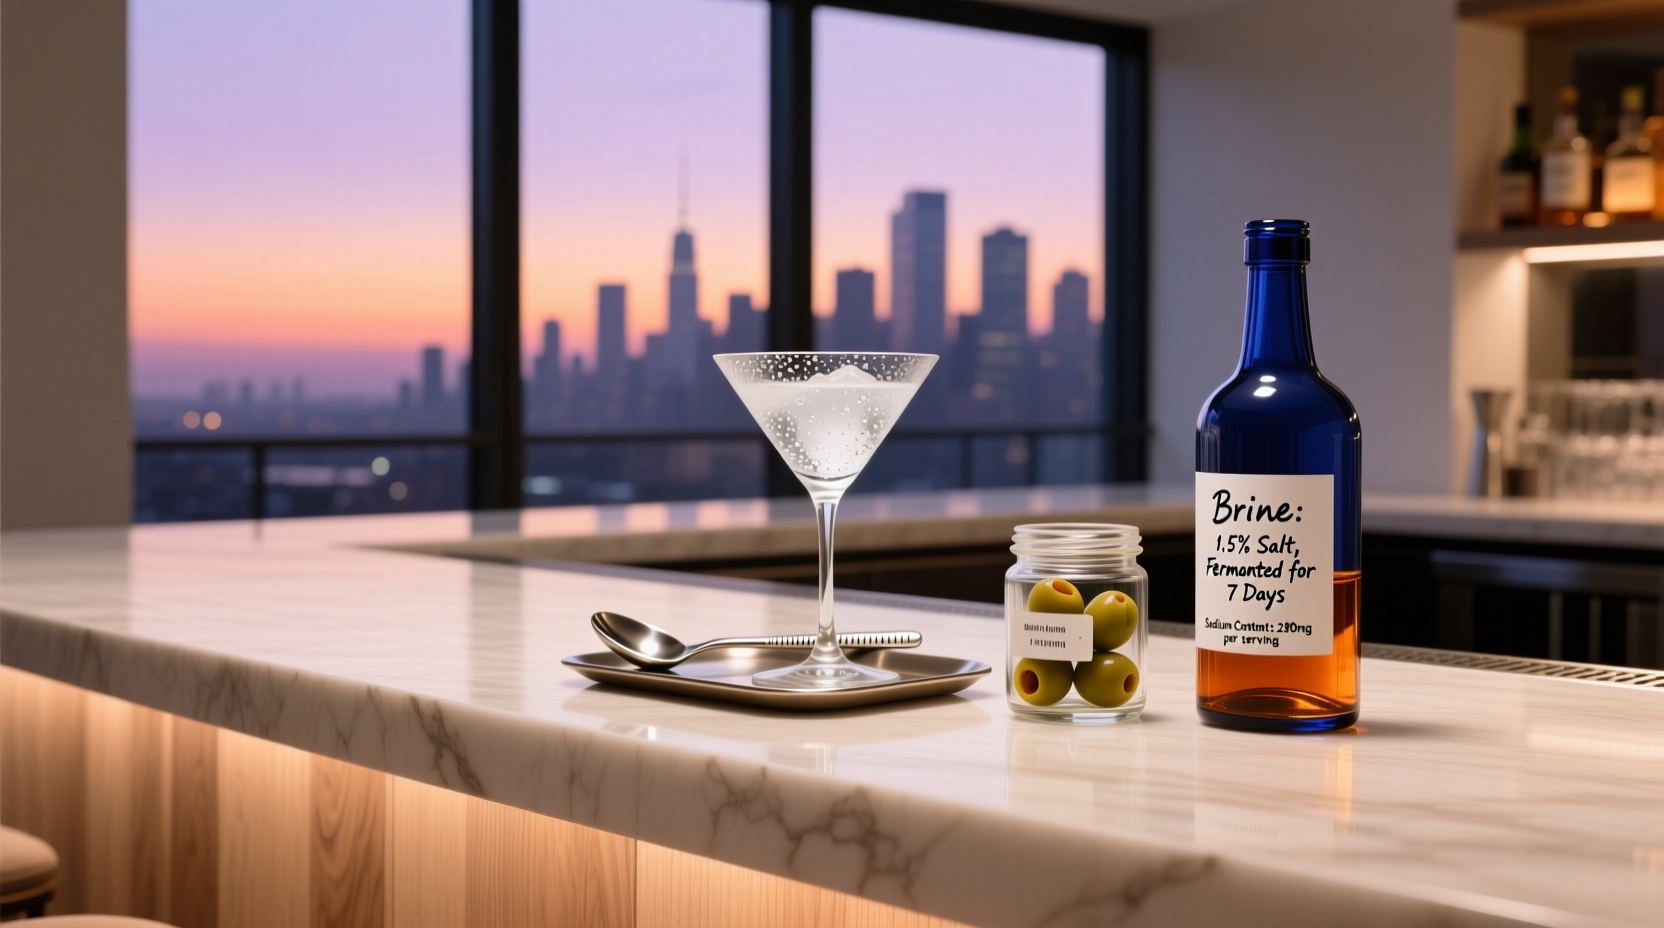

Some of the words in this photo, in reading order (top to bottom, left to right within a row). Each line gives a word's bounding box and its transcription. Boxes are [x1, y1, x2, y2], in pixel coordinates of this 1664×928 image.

[1212, 489, 1303, 525] Brine:
[1216, 534, 1251, 554] 1.5%
[1257, 533, 1300, 558] Salt,
[1288, 559, 1316, 583] for
[1227, 584, 1239, 601] 7
[1243, 583, 1285, 611] Days
